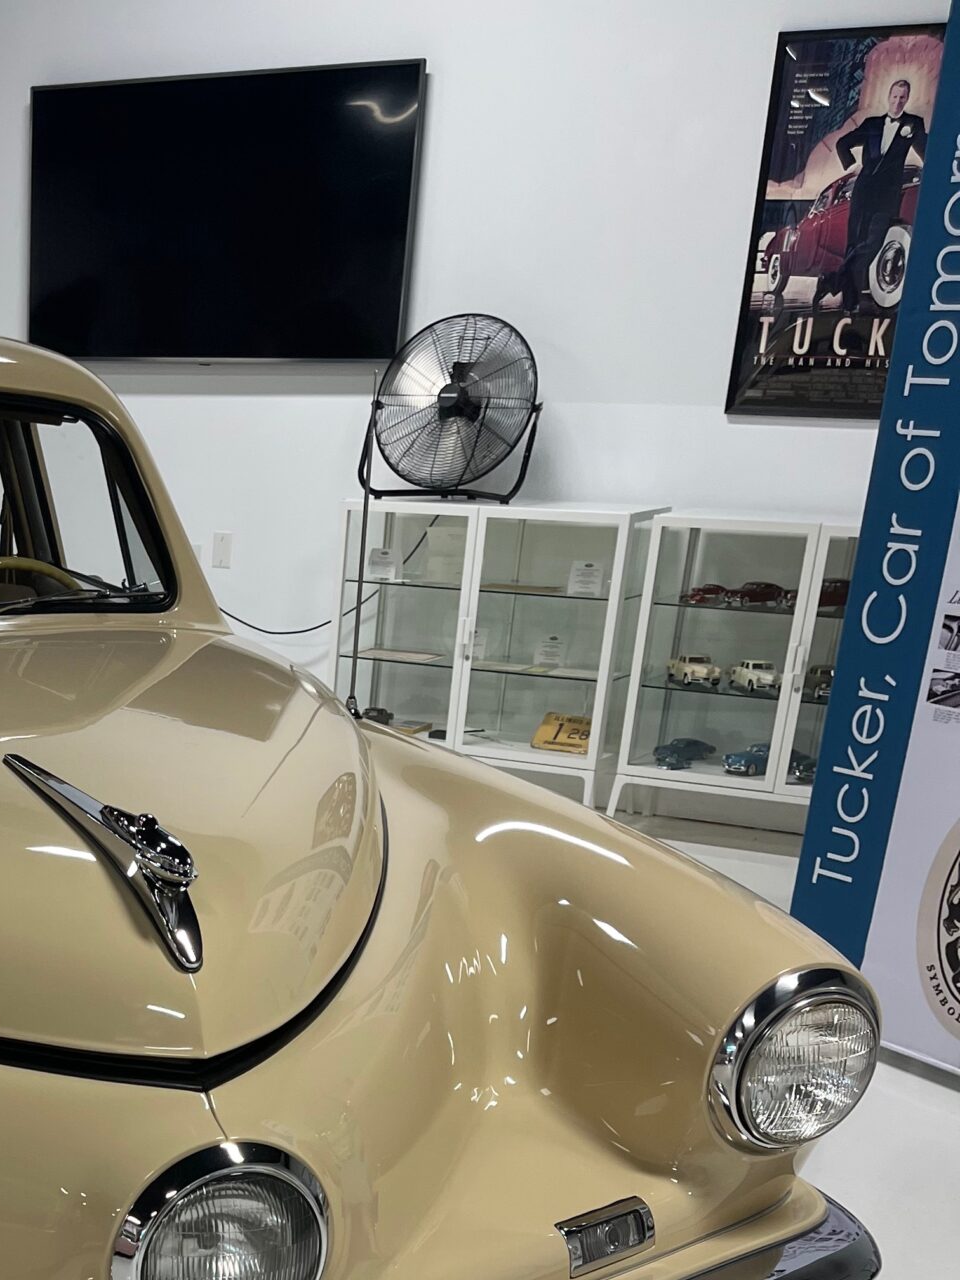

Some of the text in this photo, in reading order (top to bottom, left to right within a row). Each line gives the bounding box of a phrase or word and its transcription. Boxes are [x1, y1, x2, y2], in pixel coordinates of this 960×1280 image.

[787, 357, 815, 368] MAN
[826, 358, 851, 368] AND
[865, 359, 890, 369] HIS
[812, 133, 960, 884] Tucker, Car of Tomo
